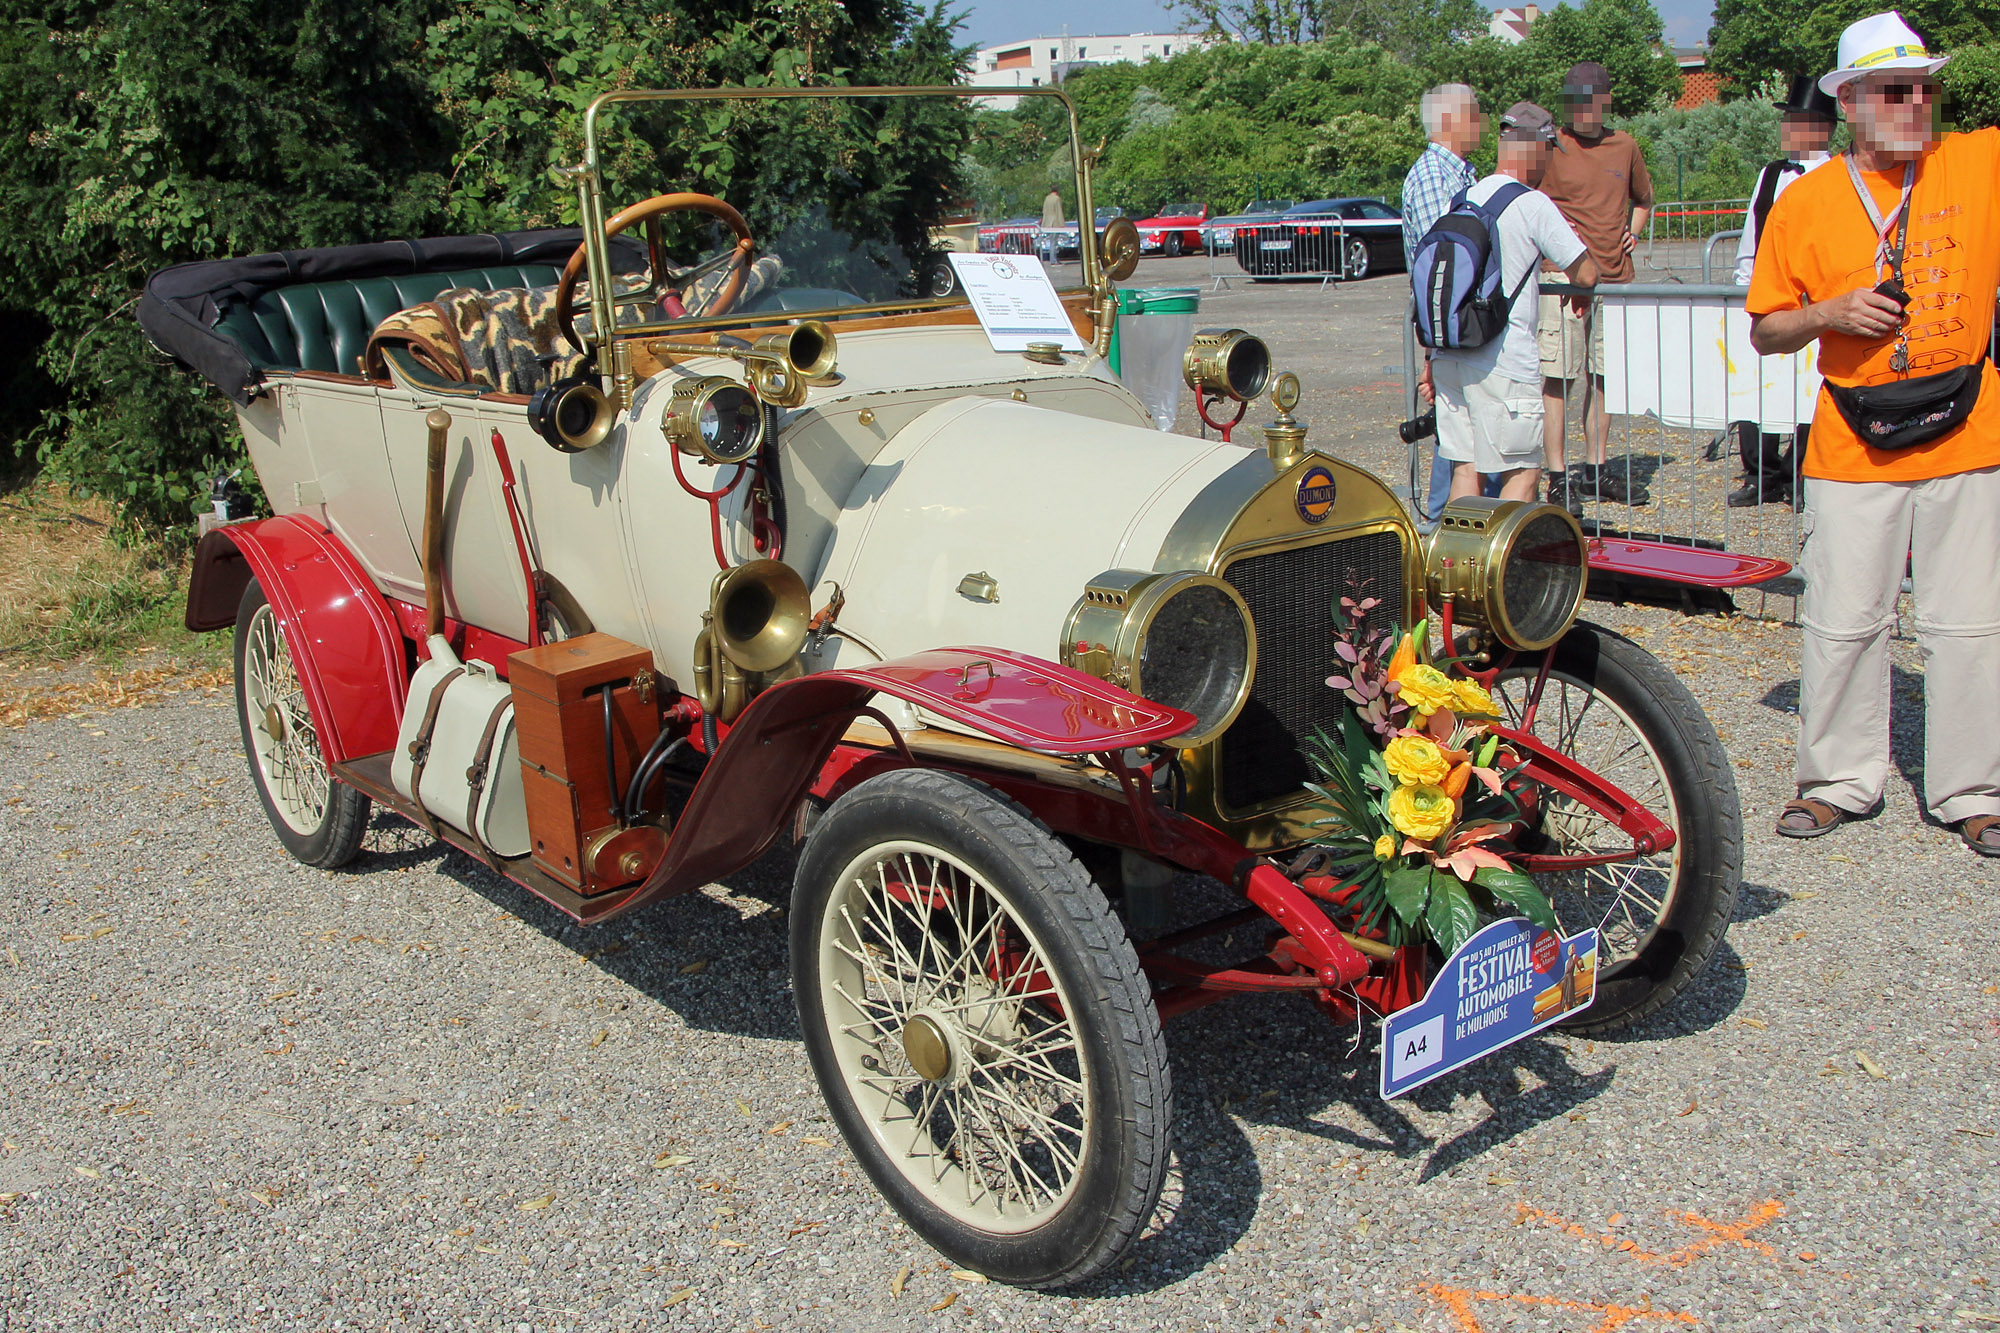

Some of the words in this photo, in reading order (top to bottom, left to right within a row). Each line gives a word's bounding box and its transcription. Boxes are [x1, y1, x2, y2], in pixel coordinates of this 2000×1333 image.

[1300, 486, 1335, 503] DUMONT
[1470, 951, 1479, 963] DU
[1479, 949, 1484, 962] 5
[1484, 945, 1492, 957] AU
[1492, 944, 1497, 956] 7
[1496, 935, 1518, 952] JUILLET
[1518, 930, 1531, 943] 2013
[1457, 942, 1534, 998] FESTIVAL
[1456, 969, 1534, 1021] AUTOMOBILE
[1455, 1021, 1467, 1041] DE
[1467, 1002, 1509, 1036] MULHOUSE
[1404, 1034, 1427, 1061] A4
